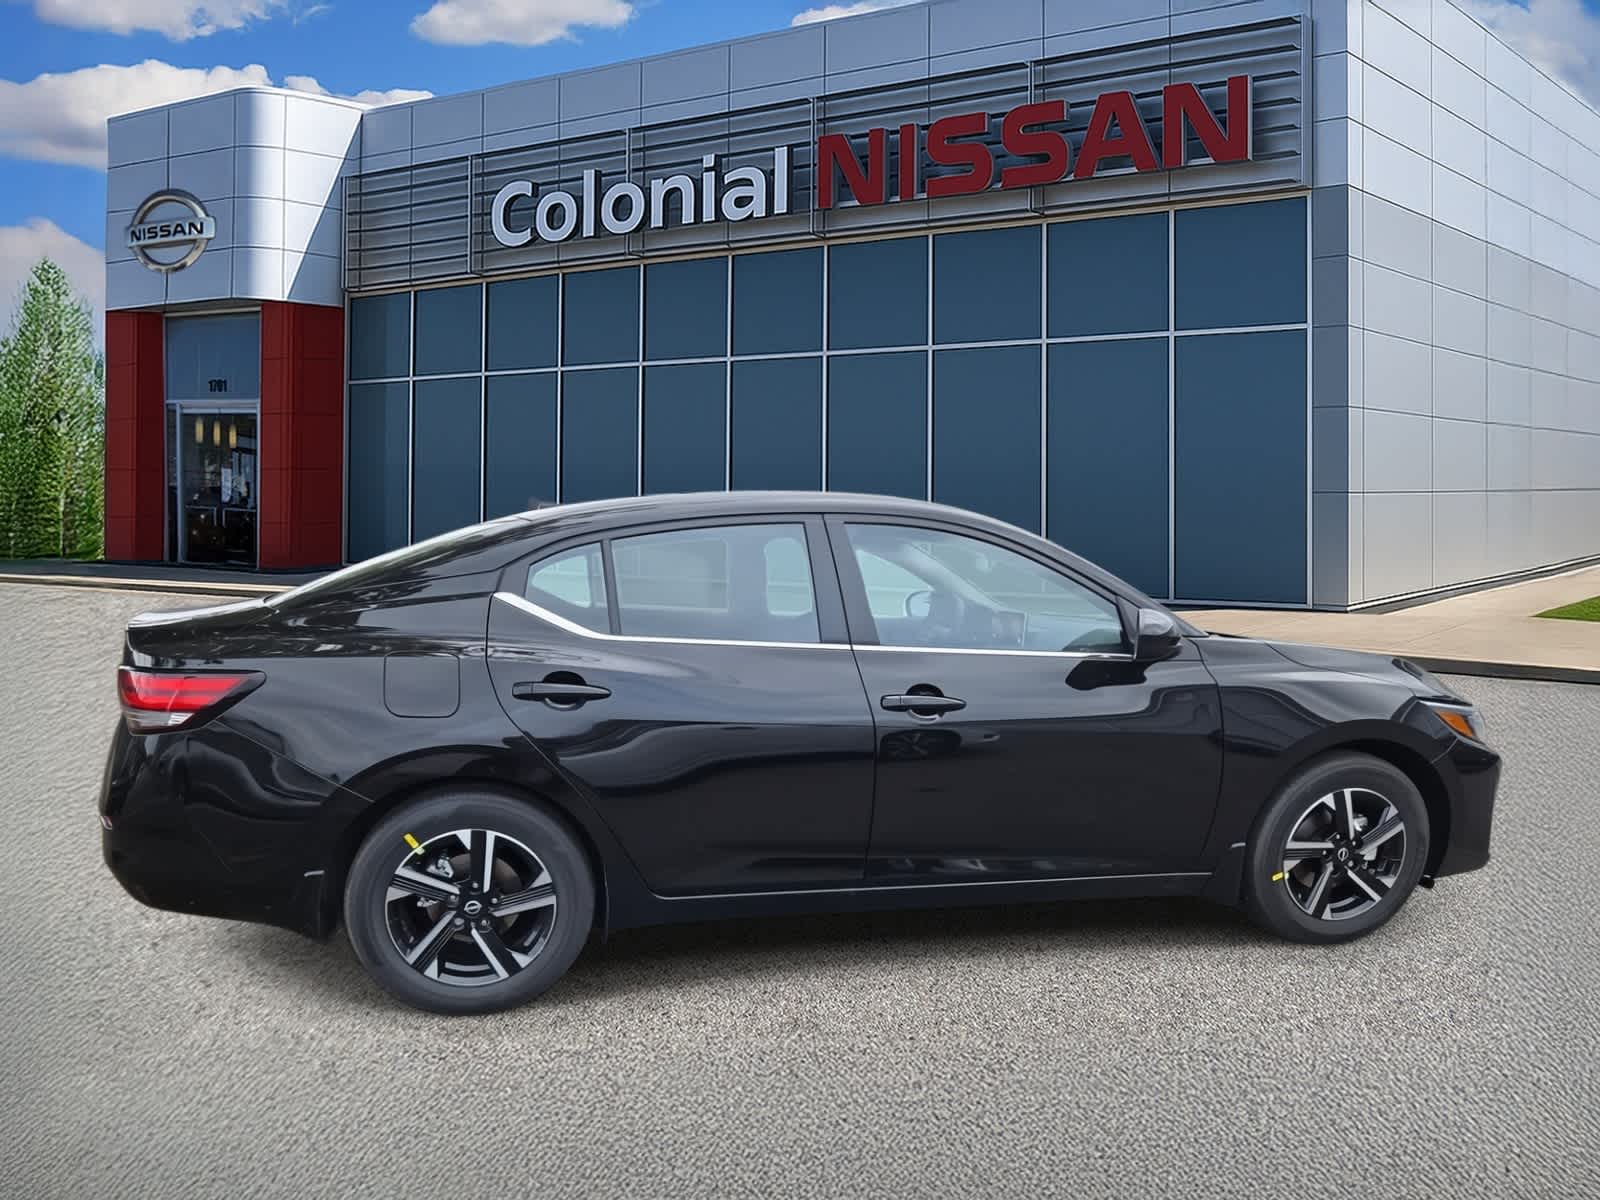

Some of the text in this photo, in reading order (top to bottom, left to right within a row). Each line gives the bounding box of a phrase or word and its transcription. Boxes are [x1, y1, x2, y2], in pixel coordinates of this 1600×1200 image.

[490, 75, 1254, 249] Colonial NISSAN
[130, 221, 204, 242] NISSAN
